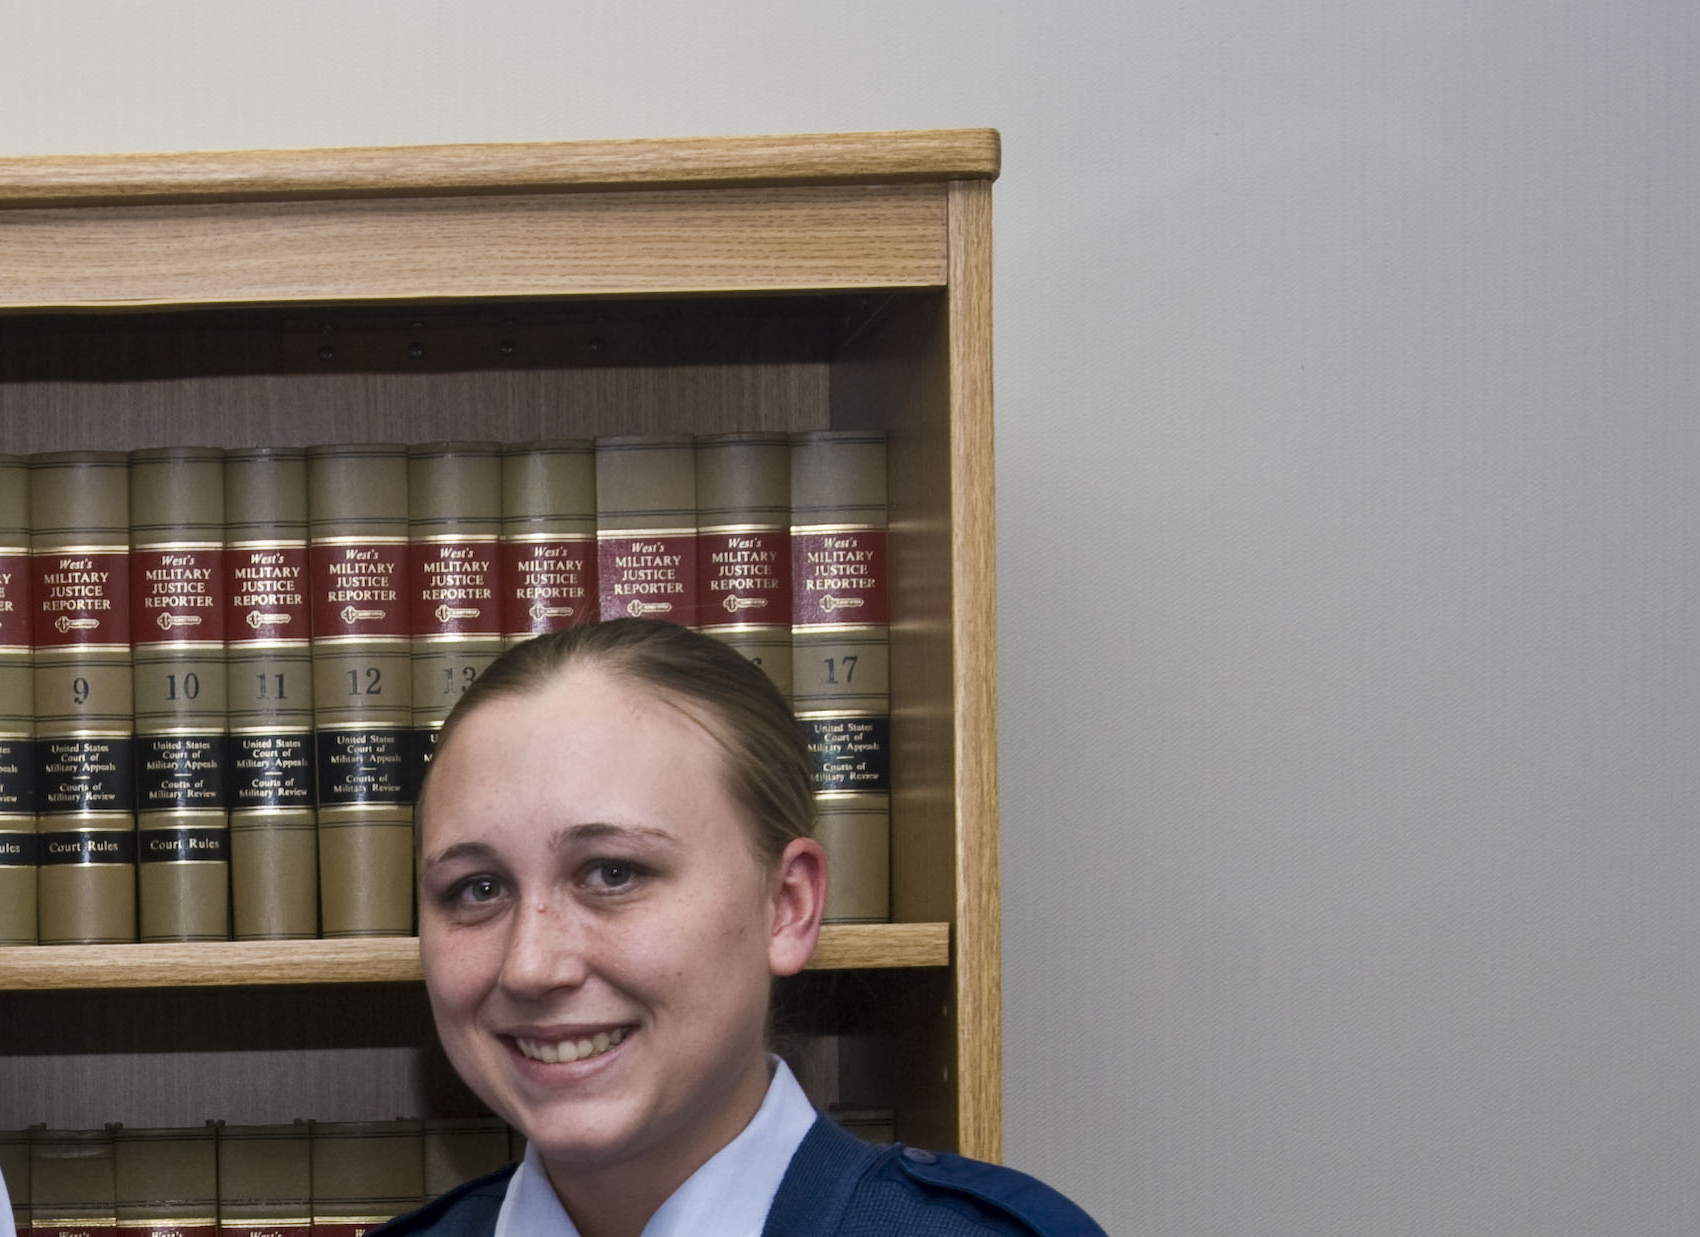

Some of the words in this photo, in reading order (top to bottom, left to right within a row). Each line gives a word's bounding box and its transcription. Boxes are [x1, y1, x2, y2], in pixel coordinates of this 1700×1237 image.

[631, 542, 665, 554] West's
[727, 537, 762, 549] West's
[823, 537, 858, 549] West's
[345, 548, 379, 560] West's
[439, 547, 474, 559] West's
[533, 546, 568, 558] West's
[808, 551, 873, 563] MILITARY
[58, 558, 93, 570] West's
[161, 555, 195, 566] West's
[250, 552, 284, 565] West's
[615, 555, 681, 567] MILITARY
[235, 567, 300, 578] MILITARY
[329, 563, 395, 574] MILITARY
[424, 561, 489, 573] MILITARY
[518, 561, 583, 572] MILITARY
[815, 564, 868, 575] JUSTICE
[43, 572, 109, 584] MILITARY
[145, 568, 212, 580] MILITARY
[523, 573, 578, 585] JUSTICE
[622, 569, 675, 580] JUSTICE
[240, 580, 294, 592] JUSTICE
[336, 576, 388, 587] JUSTICE
[431, 575, 483, 586] JUSTICE
[807, 577, 875, 589] REPORTER
[49, 585, 103, 597] JUSTICE
[153, 582, 205, 593] JUSTICE
[517, 587, 585, 598] REPORTER
[614, 582, 683, 594] REPORTER
[234, 594, 302, 605] REPORTER
[328, 590, 396, 602] REPORTER
[423, 588, 491, 600] REPORTER
[42, 599, 111, 611] REPORTER
[145, 596, 213, 607] REPORTER
[824, 656, 858, 683] 17
[166, 673, 200, 700] 10
[256, 673, 287, 699] 11
[347, 668, 381, 695] 12
[443, 667, 477, 694] 13
[73, 678, 89, 704] 9
[49, 840, 82, 853] Court
[87, 840, 118, 853] Rules
[149, 838, 183, 851] Court
[188, 837, 220, 850] Rules
